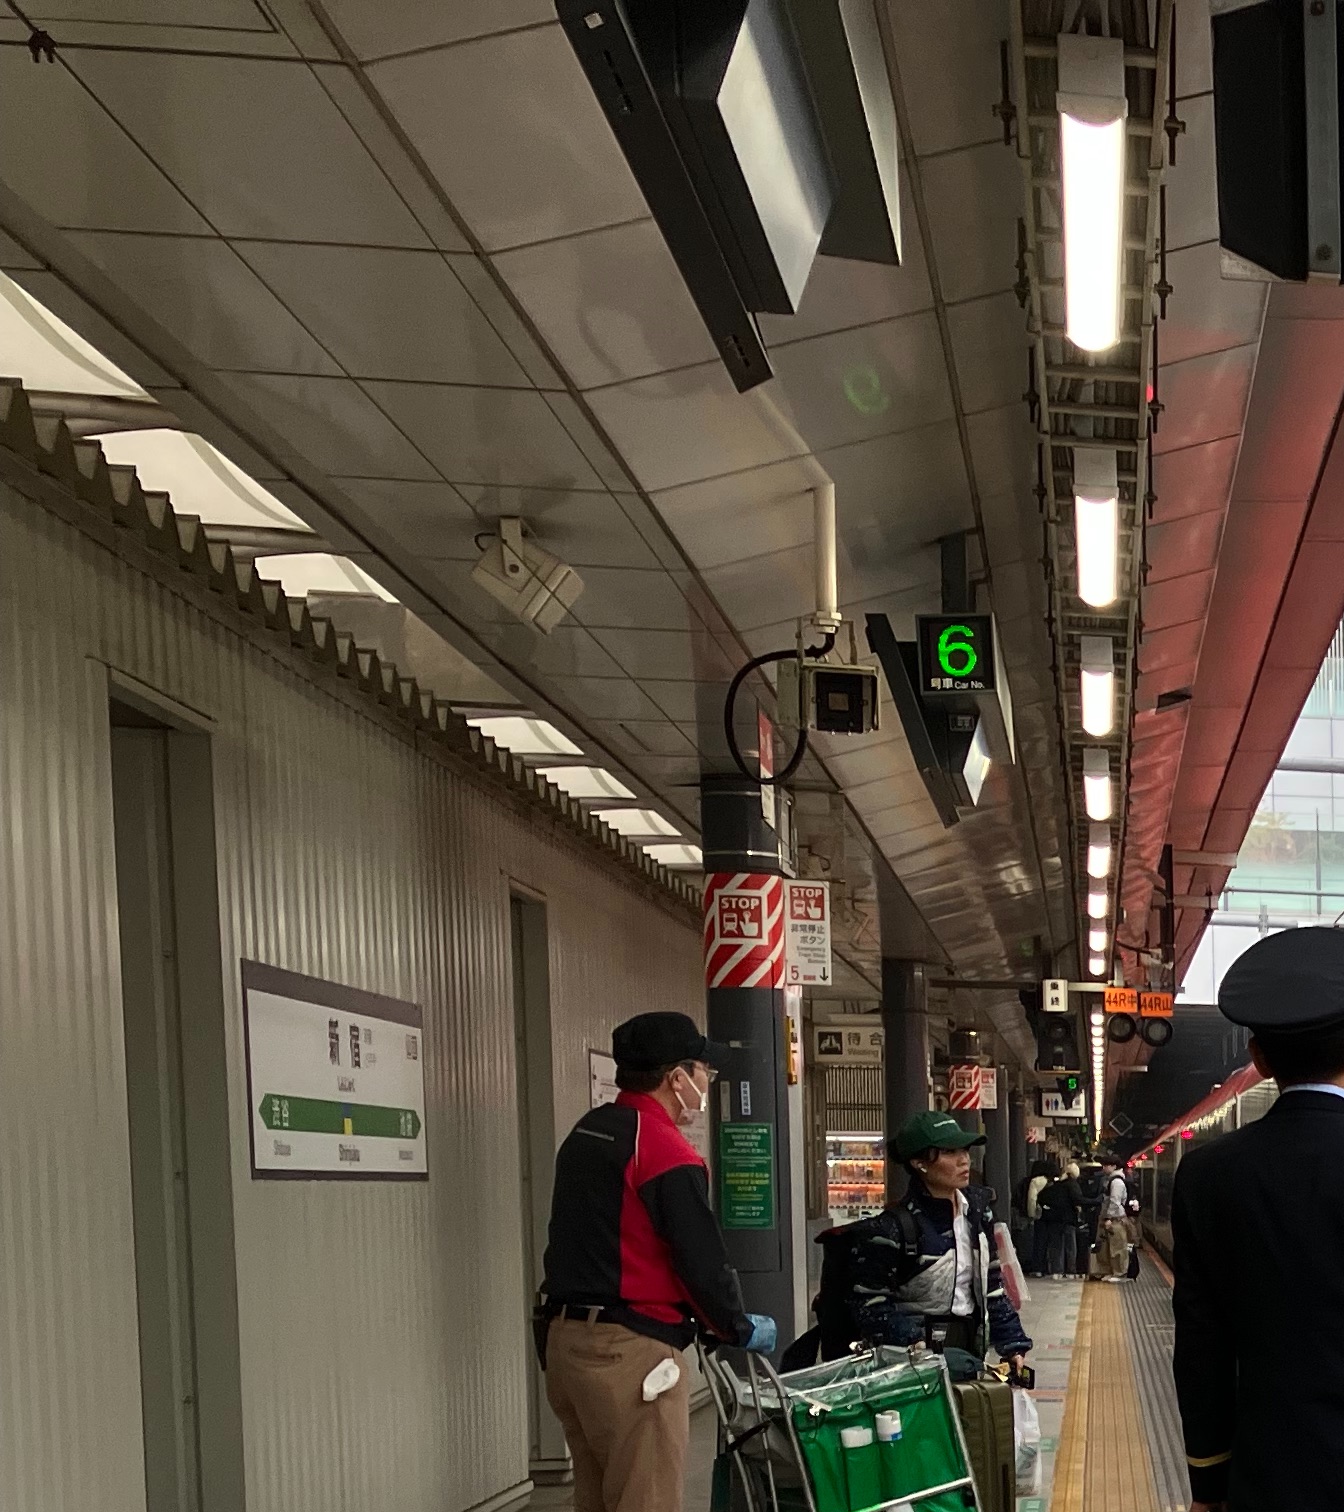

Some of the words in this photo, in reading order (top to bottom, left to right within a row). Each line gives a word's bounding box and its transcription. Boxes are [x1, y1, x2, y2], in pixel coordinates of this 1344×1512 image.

[938, 624, 977, 676] 6
[954, 681, 968, 690] Car
[970, 680, 985, 689] No.
[791, 887, 822, 898] STOP
[721, 897, 760, 910] STOP
[791, 923, 825, 934] 非常停止
[800, 936, 825, 945] ボタン
[791, 966, 799, 981] 5
